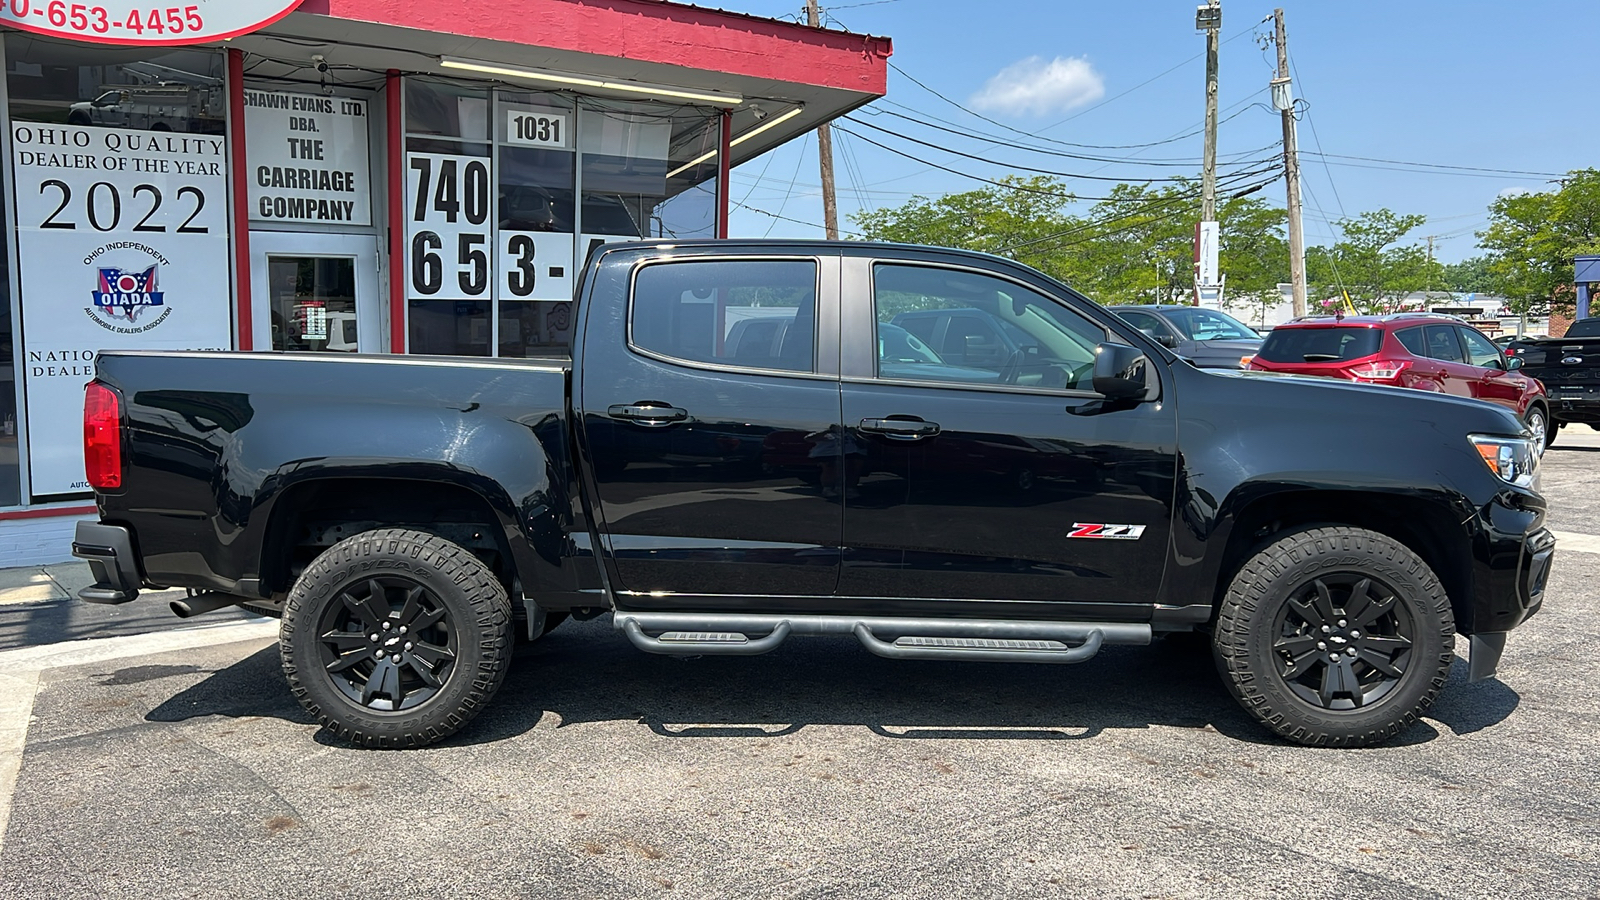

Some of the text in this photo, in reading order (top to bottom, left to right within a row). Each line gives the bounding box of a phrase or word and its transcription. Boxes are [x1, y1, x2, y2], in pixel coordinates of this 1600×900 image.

[242, 90, 366, 117] SHAWN EVANS. LTD.
[289, 116, 320, 133] DBA.
[513, 115, 560, 143] 1031
[15, 127, 224, 156] OHIO QUALITY
[287, 137, 324, 161] THE
[19, 151, 221, 176] DEALER OF THE YEAR
[257, 165, 355, 193] CARRIAGE
[411, 157, 489, 226] 740
[38, 178, 210, 234] 2022
[259, 195, 355, 221] COMPANY
[83, 241, 171, 267] OHIO INDEPENDENT
[101, 292, 153, 305] OIADA
[83, 306, 173, 335] AUTOMOBILE DEALERS ASSOCIATION
[1066, 522, 1147, 540] Z71
